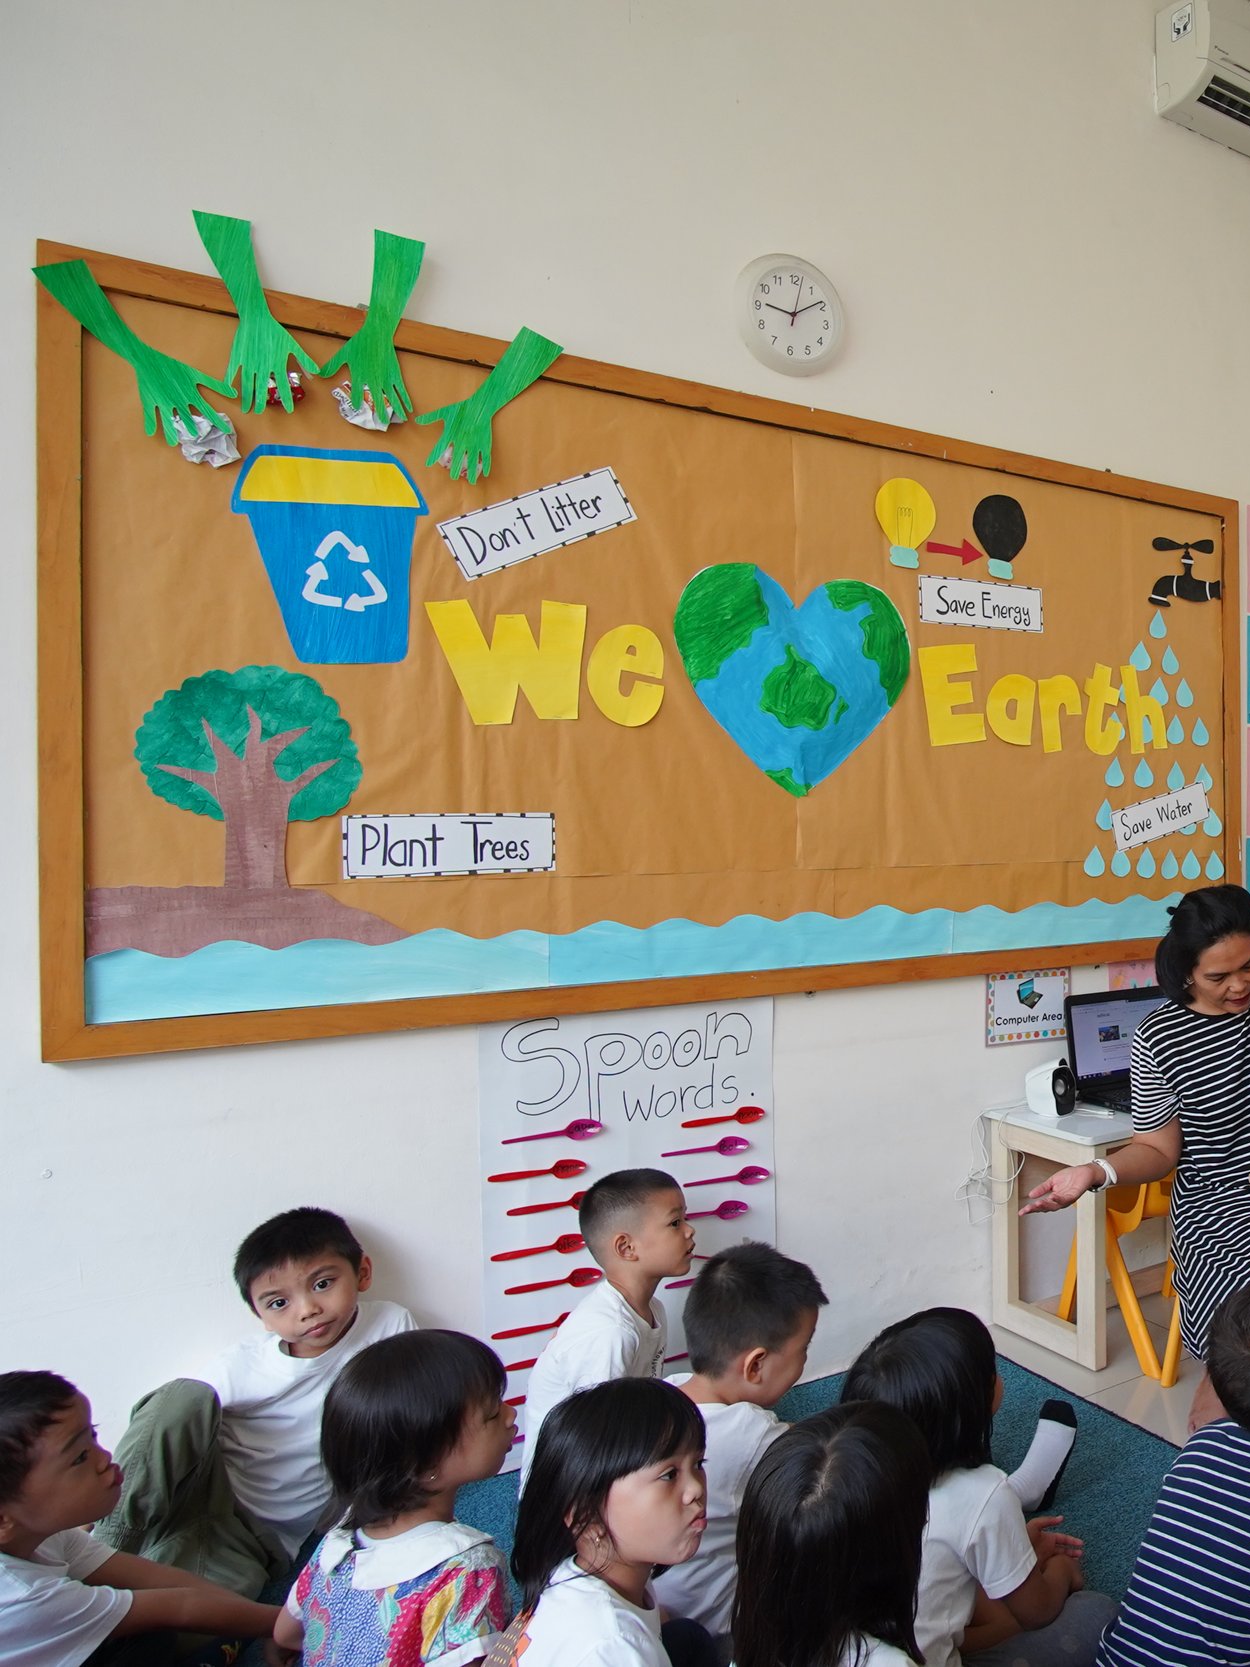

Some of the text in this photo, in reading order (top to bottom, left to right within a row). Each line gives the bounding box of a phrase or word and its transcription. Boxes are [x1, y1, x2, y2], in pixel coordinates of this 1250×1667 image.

[773, 275, 782, 286] 11
[789, 274, 800, 286] 12
[760, 283, 770, 295] 10
[809, 286, 813, 295] 1
[755, 300, 762, 310] 9
[819, 300, 826, 312] 2
[758, 319, 765, 330] 8
[822, 320, 829, 330] 3
[771, 335, 778, 345] 7
[817, 336, 823, 346] 4
[787, 345, 794, 356] 6
[804, 345, 811, 356] 5
[457, 492, 603, 566] Don't Litter
[936, 585, 1031, 627] Save Energy
[424, 599, 1168, 756] We Earth
[1120, 799, 1193, 841] Save Water
[361, 821, 530, 868] Plant Trees
[995, 1012, 1063, 1026] Computer Area
[501, 1011, 753, 1123] Spoon
